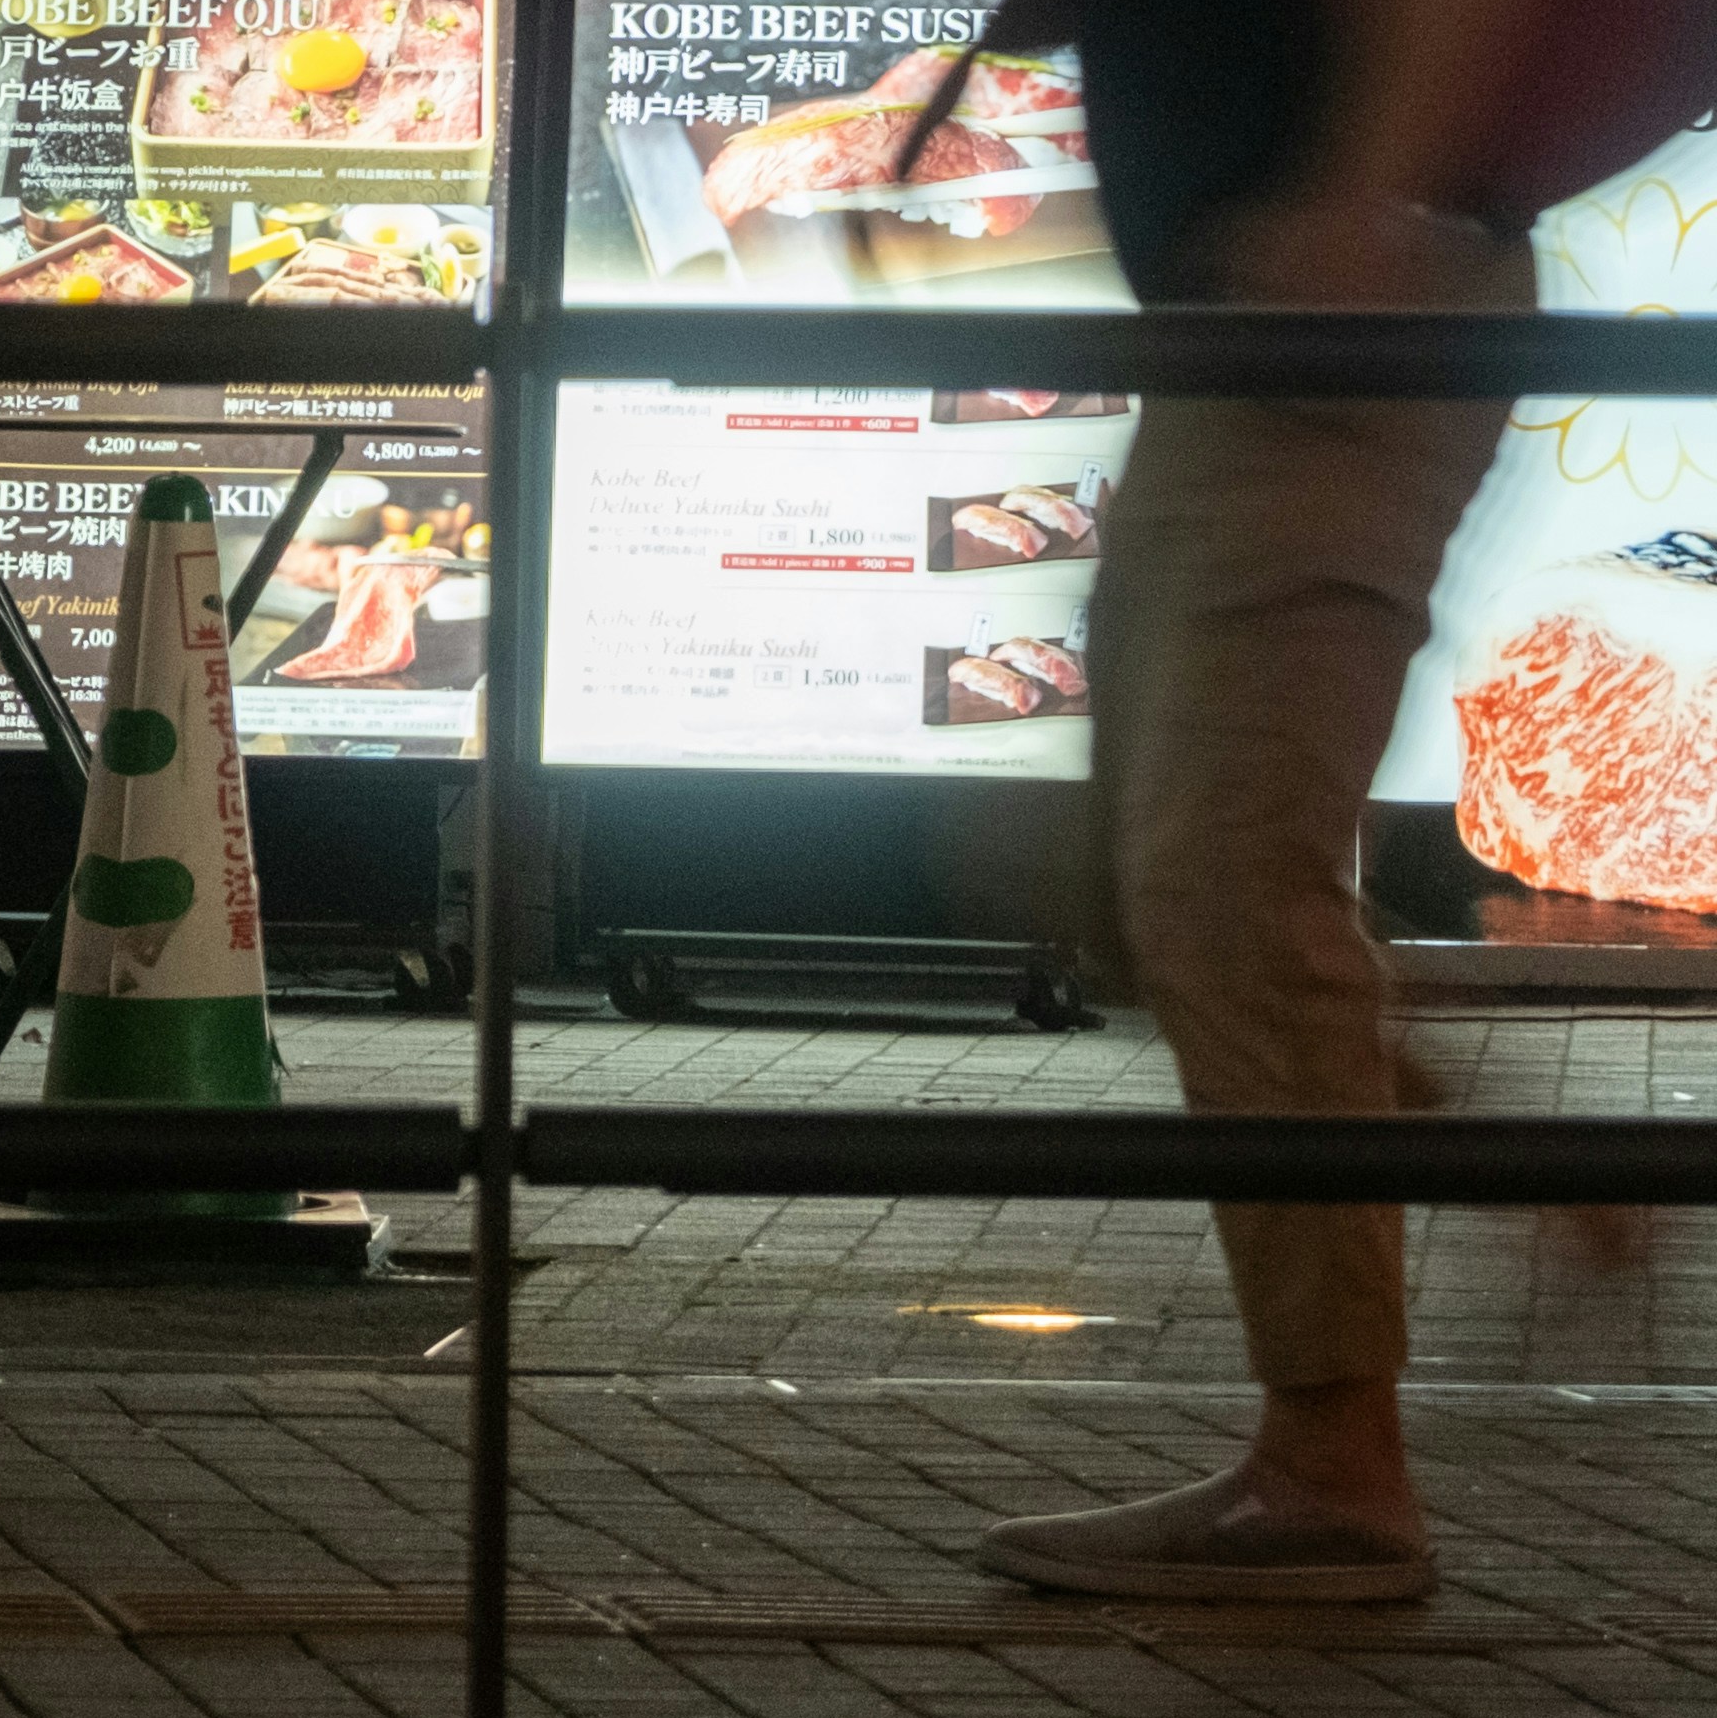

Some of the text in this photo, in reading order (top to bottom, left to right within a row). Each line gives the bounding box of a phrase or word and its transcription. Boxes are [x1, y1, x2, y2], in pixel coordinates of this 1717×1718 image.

[609, 2, 741, 40] KOBE
[749, 4, 873, 42] BEEF
[607, 46, 848, 87] 神戸ビーフ寿司
[606, 91, 769, 126] 神户牛寿司
[223, 398, 394, 418] 神戸ビーフ極上すき焼き重
[85, 437, 135, 456] 4,200
[363, 442, 415, 462] 4,800
[589, 469, 702, 491] Kobe Beef
[55, 482, 146, 514] BEE
[588, 496, 832, 519] Deluxe Yakiniku Sushi
[809, 528, 865, 548] 1,800
[18, 595, 43, 619] eef
[46, 596, 120, 616] Yakinik
[649, 609, 697, 632] Beef
[70, 627, 116, 650] 7,00
[661, 637, 754, 658] Yakiniku
[760, 638, 820, 660] Sushi
[804, 669, 860, 687] 1,500
